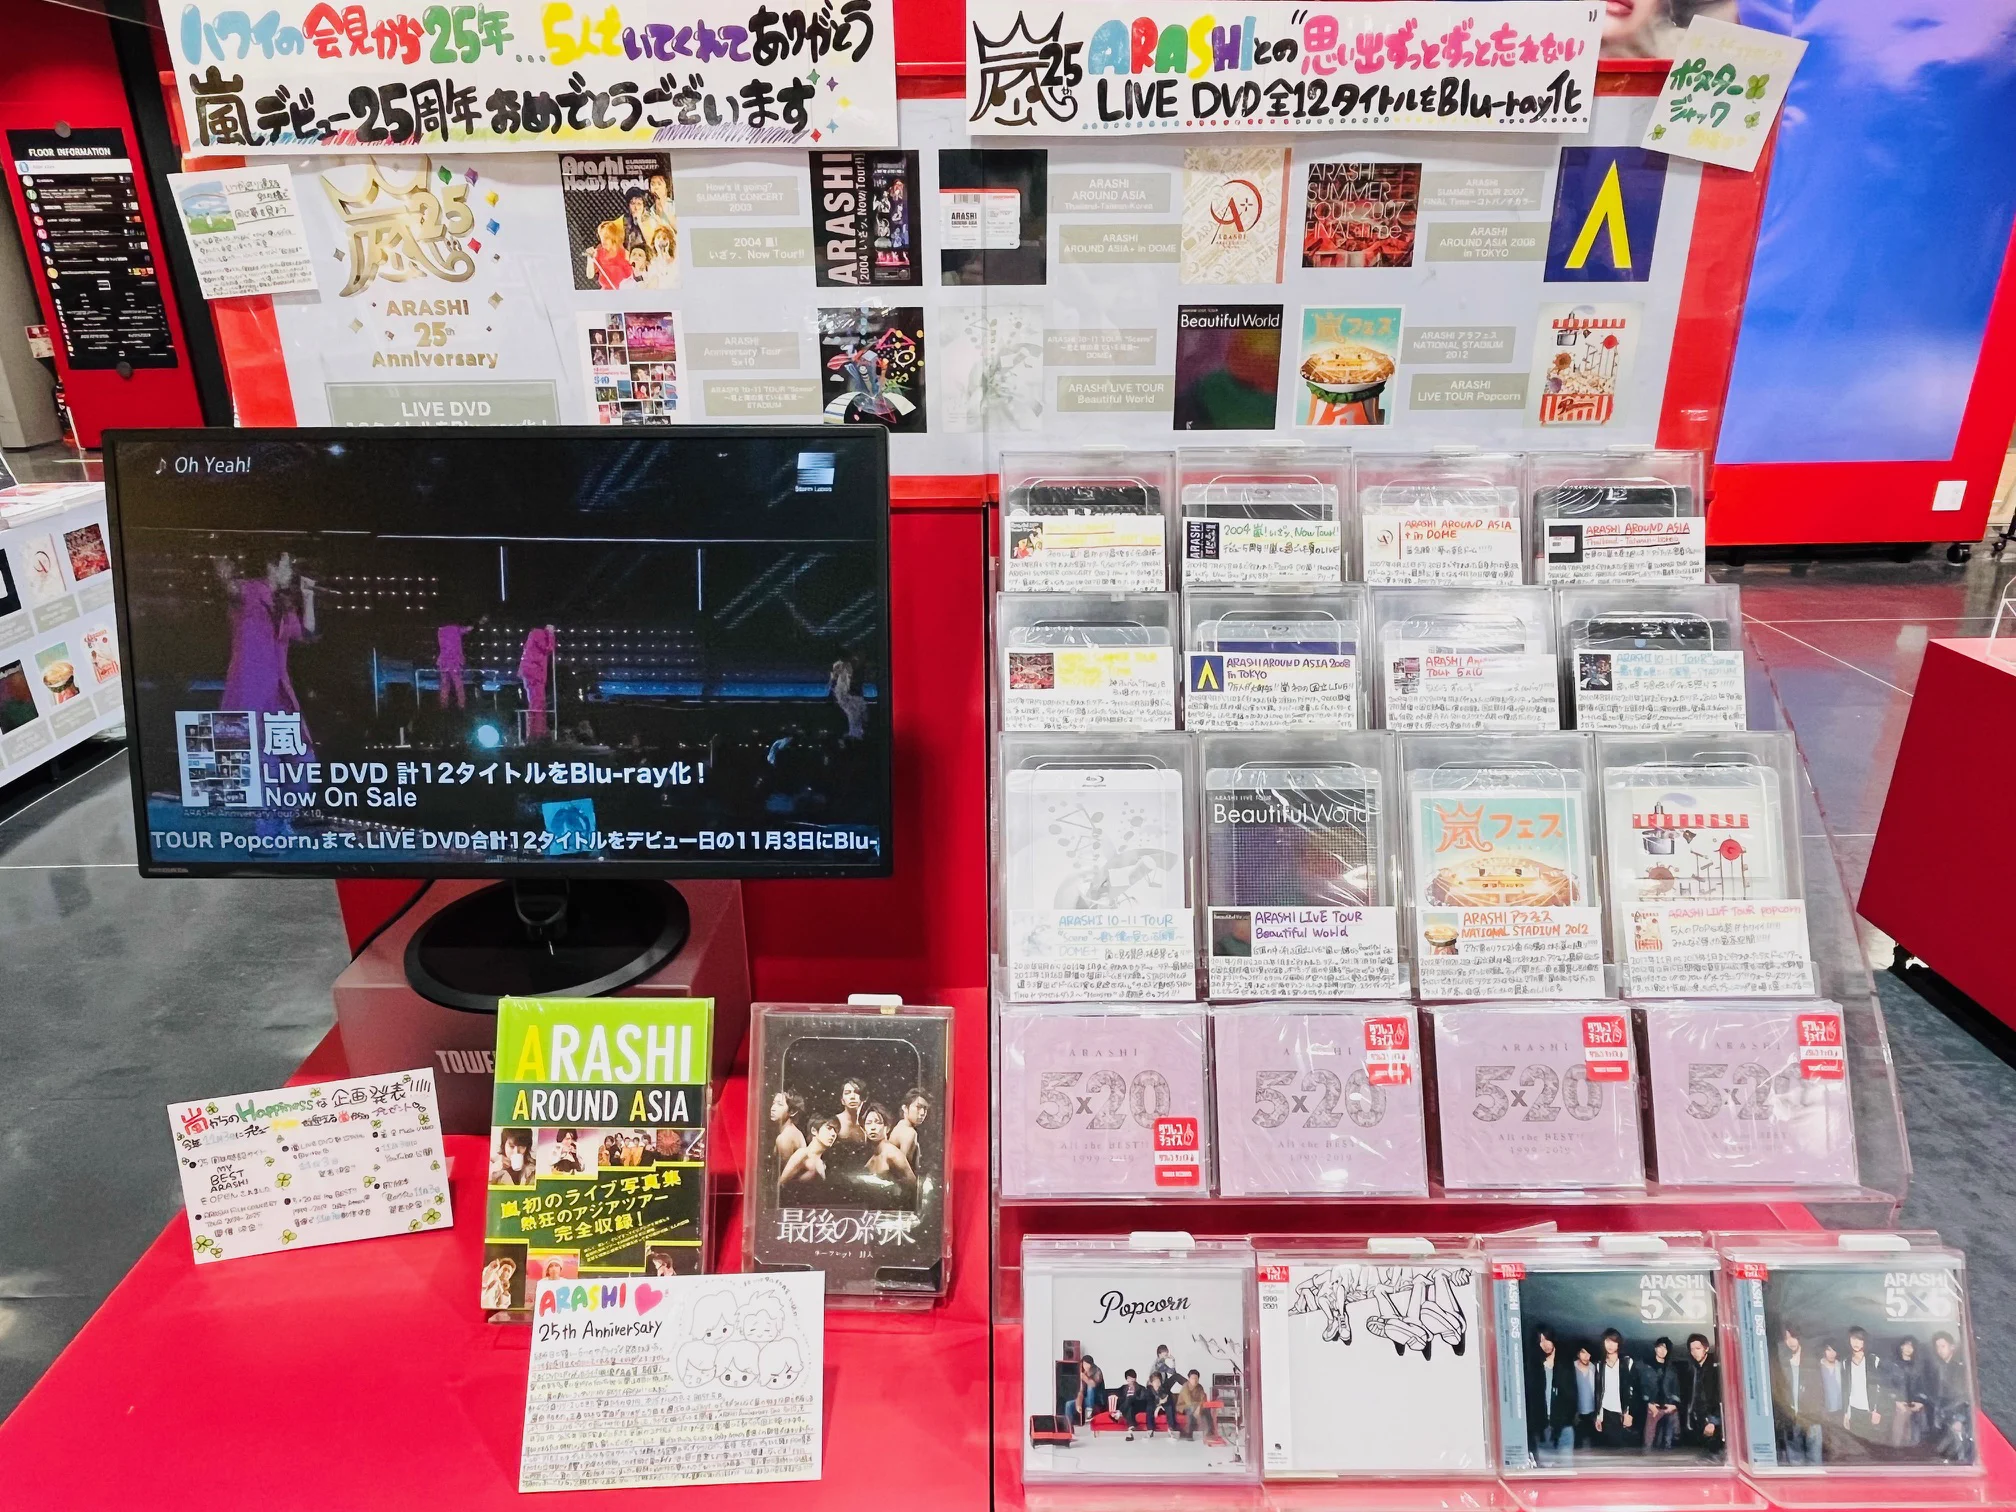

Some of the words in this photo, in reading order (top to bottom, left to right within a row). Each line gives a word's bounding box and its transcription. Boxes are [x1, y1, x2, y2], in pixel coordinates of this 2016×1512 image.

[1097, 79, 1178, 122] LIVE
[28, 148, 55, 157] FLOOR
[57, 147, 111, 156] INFORMATION
[1308, 162, 1376, 181] ARASHI
[1089, 178, 1130, 189] ARASHI
[1307, 181, 1392, 200] SUMMER
[1072, 191, 1119, 201] AROUND
[1121, 190, 1147, 200] ASIA
[1307, 201, 1357, 220] TOUR
[1360, 201, 1406, 220] 2007
[821, 153, 859, 285] ARASHI
[1102, 233, 1139, 243] ARASHI
[1470, 227, 1508, 236] ARASHI
[734, 237, 762, 247] 2004
[1064, 244, 1105, 253] AROUND
[1148, 243, 1177, 253] DOME
[1440, 238, 1483, 247] AROUND
[1484, 238, 1508, 247] ASIA
[747, 249, 770, 259] Now
[1475, 248, 1509, 258] TOKYO
[386, 300, 469, 316] ARASHI
[1181, 313, 1240, 328] Beautiful
[1242, 313, 1280, 327] World
[1420, 331, 1456, 340] ARASHI
[1413, 341, 1460, 350] NATIONAL
[1462, 340, 1504, 349] STADIUM
[372, 350, 499, 369] Anniversary
[1445, 350, 1469, 359] 2012
[1068, 383, 1108, 393] ARASHI
[1110, 383, 1133, 393] LIVE
[1136, 383, 1165, 393] TOUR
[1450, 380, 1491, 390] ARASHI
[1077, 394, 1122, 404] Beautiful
[1125, 394, 1155, 404] World
[1417, 391, 1442, 401] LIVE
[1444, 391, 1474, 401] TOUR
[1476, 391, 1521, 403] Popcorn
[401, 401, 445, 417] LIVE
[449, 401, 491, 416] DVD
[174, 456, 199, 474] Oh
[204, 456, 251, 474] Yeah!
[1223, 522, 1251, 536] 2004
[1404, 520, 1438, 530] ARASHI
[1441, 519, 1484, 530] AROUND
[1488, 520, 1512, 530] ASIA
[1586, 524, 1621, 535] ARASHI
[1625, 523, 1664, 534] AROUND
[1667, 522, 1691, 533] ASIA
[1427, 529, 1458, 540] DOME
[1262, 658, 1301, 669] AROUND
[1303, 659, 1329, 669] ASIA
[1425, 656, 1462, 667] ARASHI
[1239, 670, 1268, 680] TOKYO
[263, 711, 308, 757] 嵐
[263, 763, 323, 784] LIVE
[330, 763, 389, 784] DVD
[265, 790, 317, 807] Now
[324, 787, 358, 807] On
[366, 786, 418, 807] Sale
[1214, 803, 1308, 824] Beautiful
[1310, 802, 1371, 823] World
[152, 831, 213, 850] TOUR
[1059, 915, 1103, 927] ARASHI
[1108, 915, 1137, 926] 10-11
[1143, 914, 1174, 927] TOUR
[1254, 912, 1296, 925] ARASHI
[1299, 911, 1328, 923] LIVE
[1334, 910, 1363, 923] TOUR
[1463, 912, 1507, 926] ARASHI
[1256, 927, 1308, 940] Beautiful
[1313, 926, 1349, 938] World
[1513, 925, 1561, 937] STADIUM
[1565, 924, 1590, 935] 2012
[514, 1024, 693, 1083] ARASHI
[1068, 1048, 1139, 1058] ARASHI
[1501, 1042, 1569, 1052] ARASHI
[435, 1050, 496, 1073] TOWE
[511, 1088, 619, 1122] AROUND
[628, 1089, 690, 1122] ASIA
[210, 1169, 245, 1186] BEST
[210, 1178, 249, 1194] ARASHI
[500, 1168, 683, 1220] 嵐初のライブ写真集
[777, 1208, 919, 1246] 最後の約束
[1640, 1274, 1704, 1289] ARASHI
[1884, 1272, 1949, 1288] ARASHI
[538, 1282, 627, 1318] ARASHI
[1092, 1290, 1192, 1325] Popcorn
[538, 1322, 578, 1343] 25th
[582, 1319, 664, 1341] Anniversary
